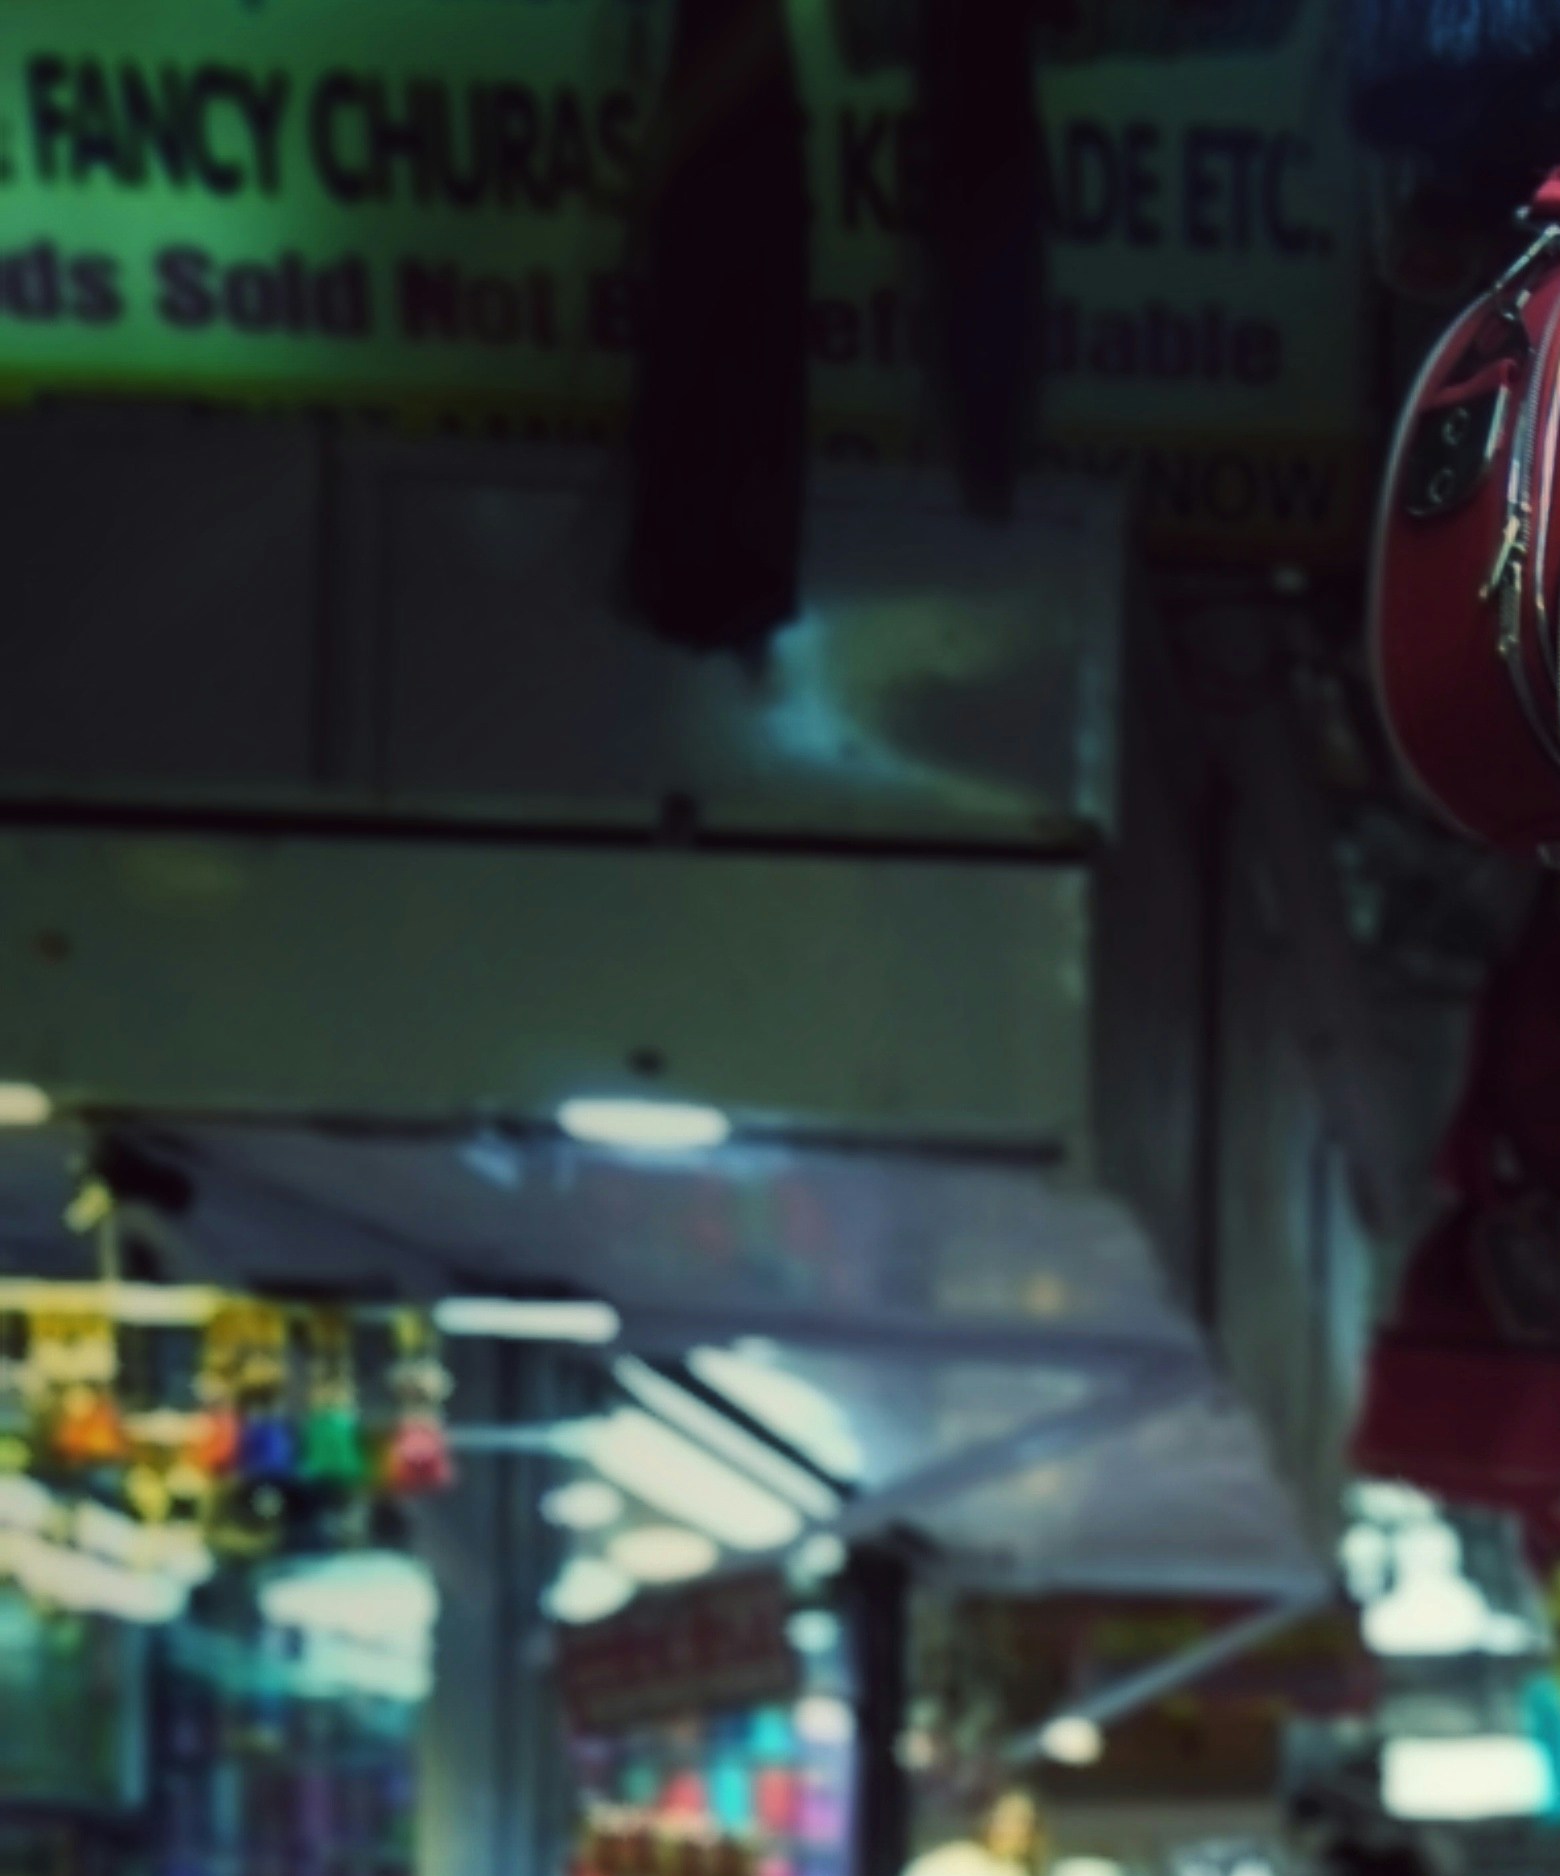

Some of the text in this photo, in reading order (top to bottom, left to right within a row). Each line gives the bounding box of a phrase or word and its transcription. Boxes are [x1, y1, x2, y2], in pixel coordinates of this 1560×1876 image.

[28, 55, 293, 198] FANCY
[310, 66, 640, 210] CHURAS
[1180, 116, 1336, 258] ETC.
[155, 240, 372, 342] Sold
[398, 250, 558, 352] Not
